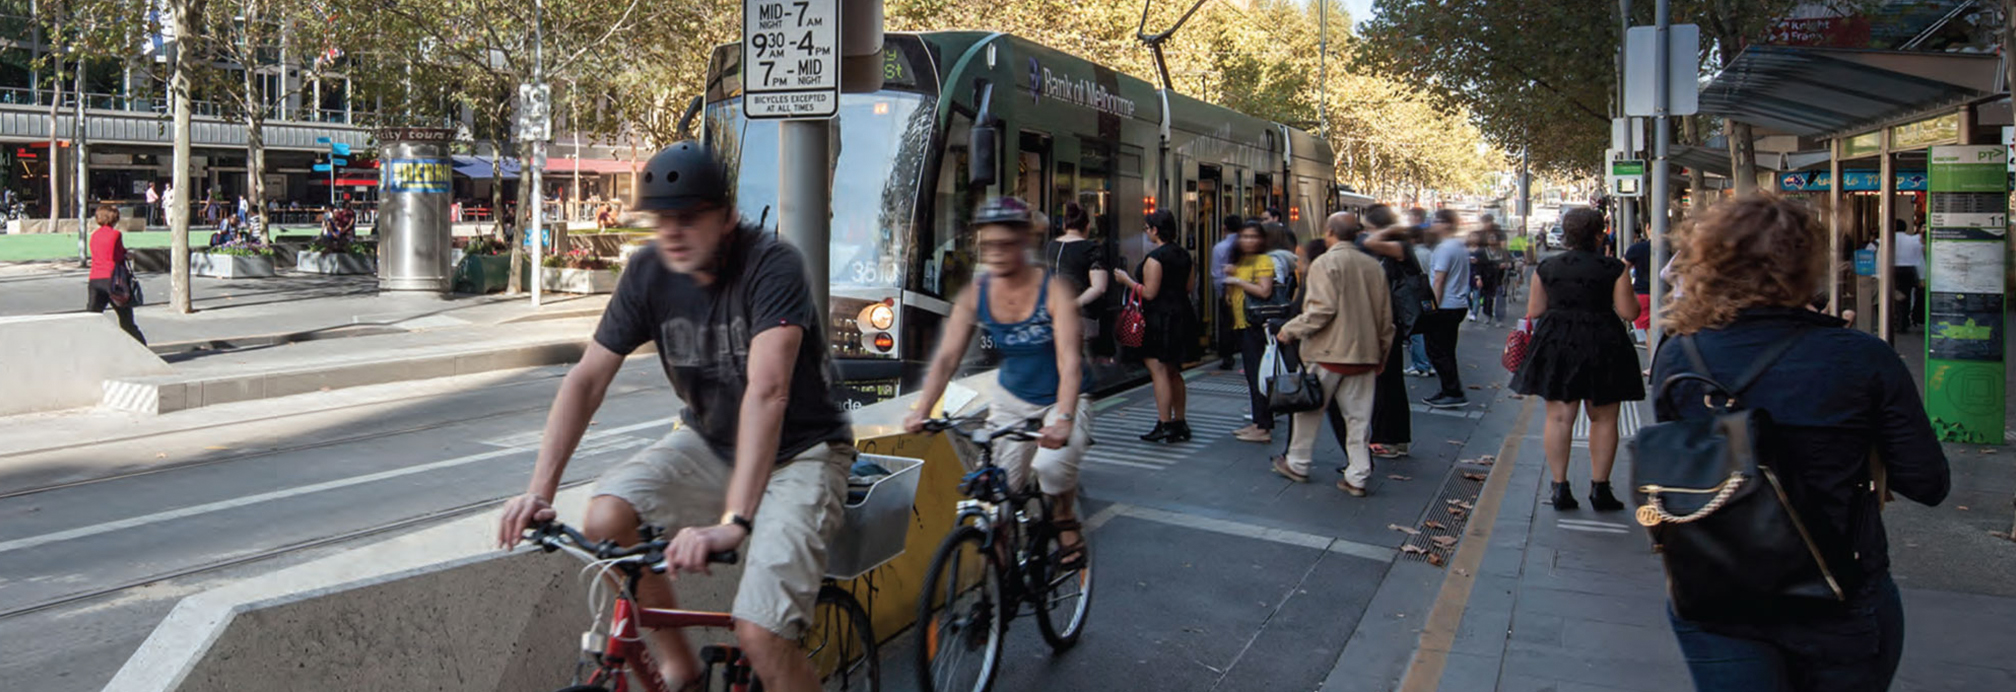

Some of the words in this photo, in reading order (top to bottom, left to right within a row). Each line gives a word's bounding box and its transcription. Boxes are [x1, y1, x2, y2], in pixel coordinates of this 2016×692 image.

[759, 3, 783, 20] MID
[806, 18, 822, 26] AM
[759, 20, 782, 29] NIGHT
[769, 50, 784, 58] AM
[815, 47, 830, 55] PM
[772, 78, 787, 86] PM
[798, 59, 822, 75] MID
[798, 76, 822, 84] NIGHT
[1043, 67, 1072, 99] Bank
[1073, 80, 1084, 102] of
[1084, 80, 1135, 115] Melbourne
[754, 96, 789, 104] BICYCLES
[790, 94, 827, 103] EXCEPTED
